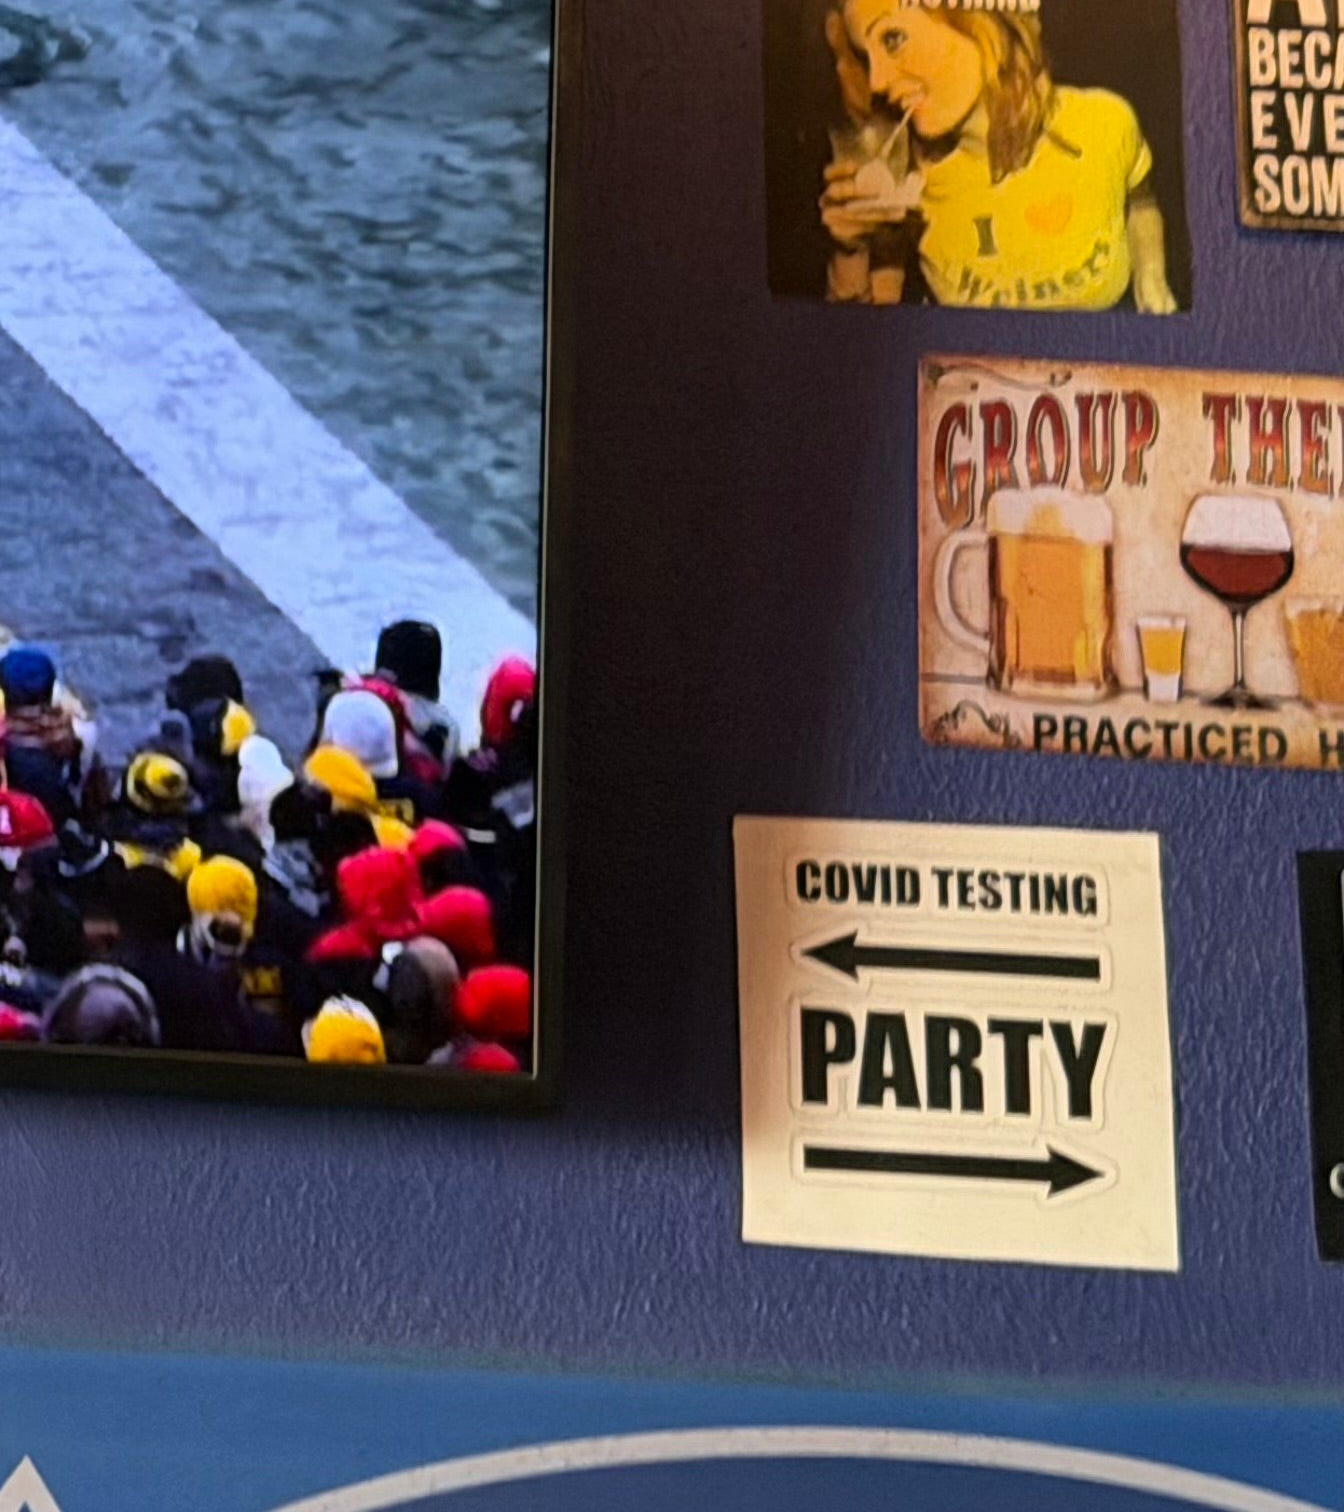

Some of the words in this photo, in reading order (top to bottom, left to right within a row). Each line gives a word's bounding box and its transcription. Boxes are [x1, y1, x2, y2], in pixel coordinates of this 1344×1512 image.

[972, 214, 998, 256] I
[934, 391, 1160, 530] GROUP
[1202, 391, 1344, 500] THE
[1033, 712, 1288, 764] PRACTICED
[796, 859, 921, 908] COVID
[931, 866, 1099, 917] TESTING
[800, 1005, 1108, 1121] PARTY
